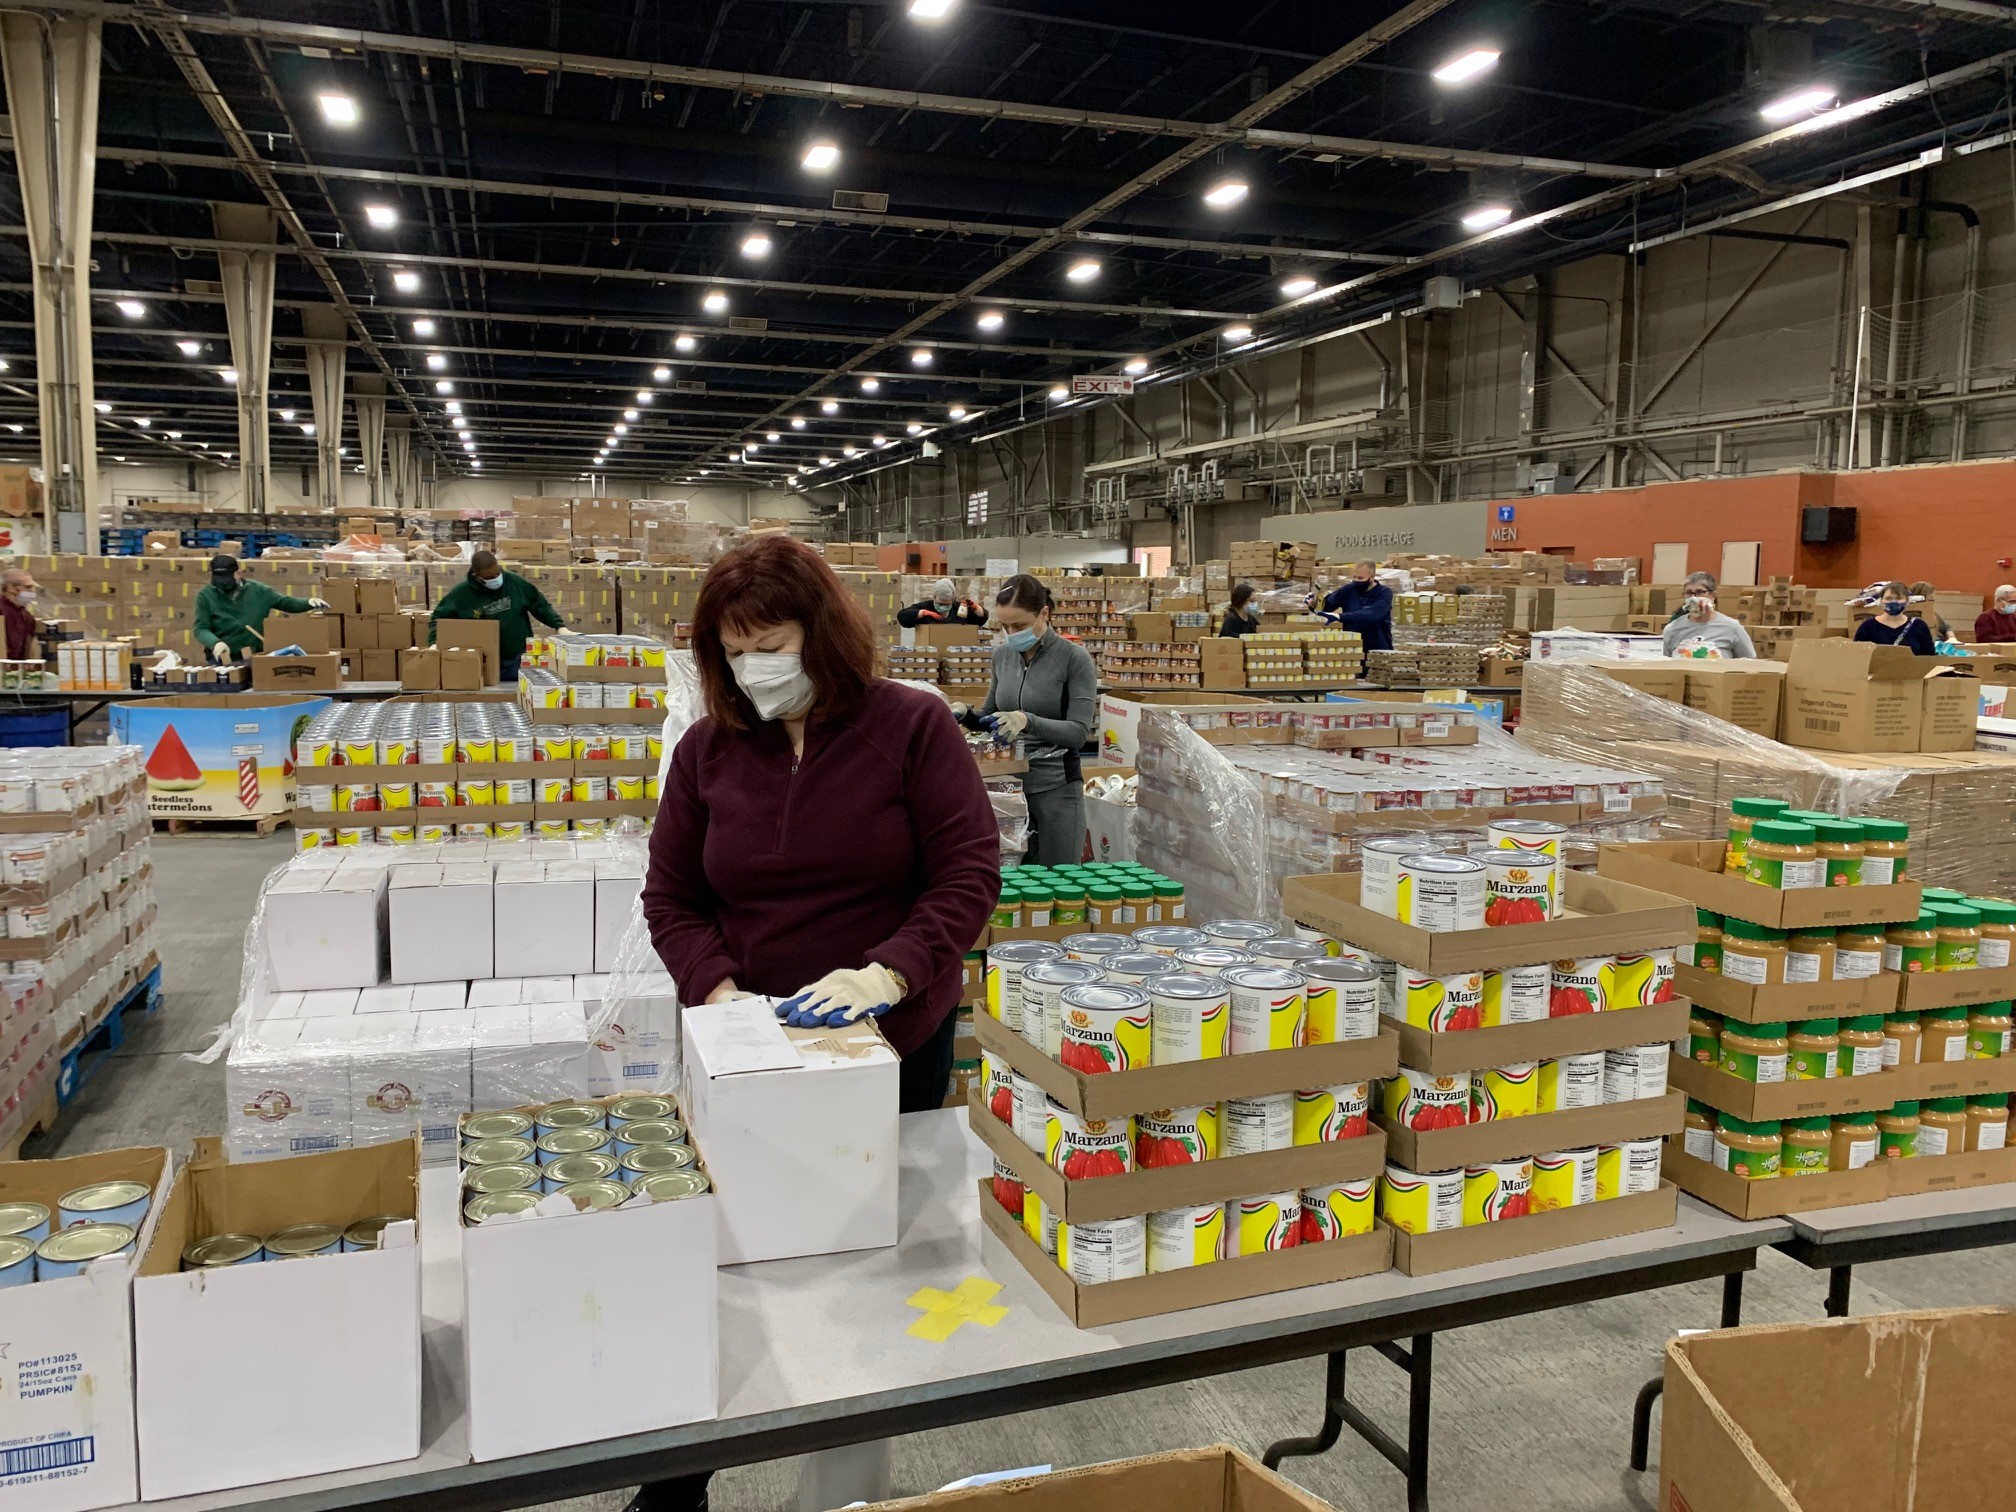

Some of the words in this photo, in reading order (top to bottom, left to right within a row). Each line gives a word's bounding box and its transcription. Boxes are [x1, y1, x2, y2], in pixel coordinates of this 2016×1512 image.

[1074, 382, 1122, 392] EXIT
[1491, 526, 1517, 541] MEN
[151, 795, 194, 803] Seedless
[1486, 880, 1547, 894] Marzano
[1135, 1113, 1195, 1135] Marzano
[1064, 1130, 1127, 1147] Marzano
[18, 1352, 78, 1369] PO#113025
[19, 1363, 83, 1380] PRSIC#8152
[19, 1378, 53, 1389] 24/15oz
[55, 1374, 78, 1383] Cans
[20, 1384, 73, 1400] PUMPKIN
